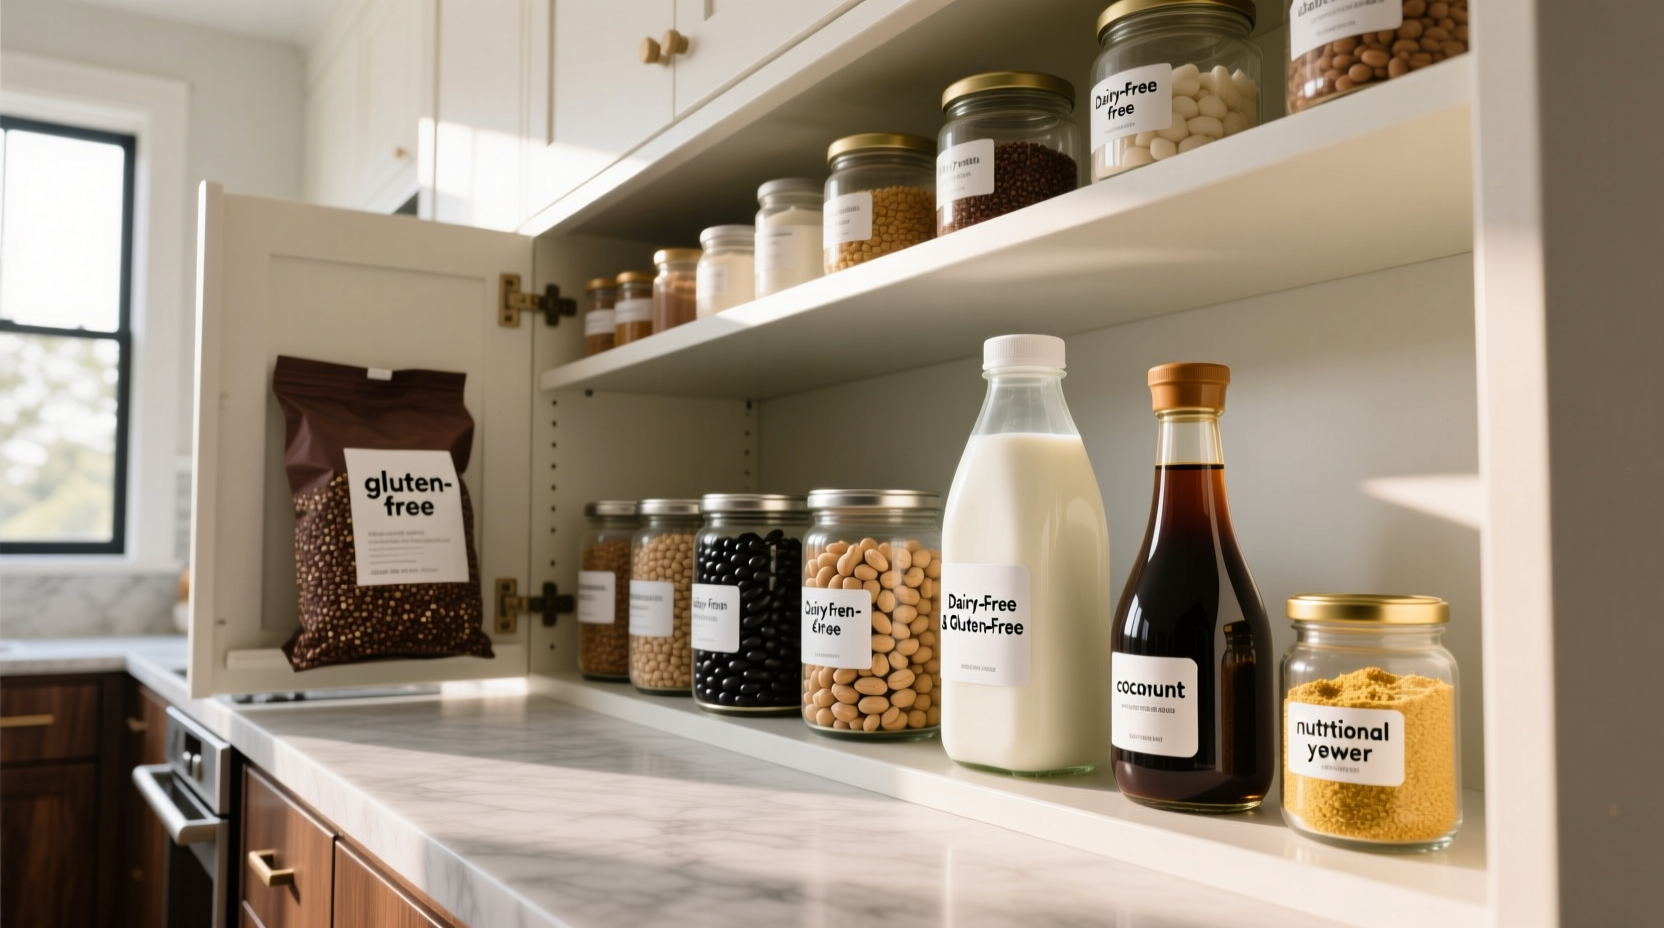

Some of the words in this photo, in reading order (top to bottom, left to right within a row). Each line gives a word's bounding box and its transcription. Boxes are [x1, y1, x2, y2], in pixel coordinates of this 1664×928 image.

[1095, 81, 1157, 110] Dairy-Free
[1108, 104, 1135, 121] free
[364, 470, 453, 499] gluten-
[384, 495, 434, 516] free
[948, 593, 1017, 614] Dairy-Free
[949, 613, 1024, 635] Gluten-Free
